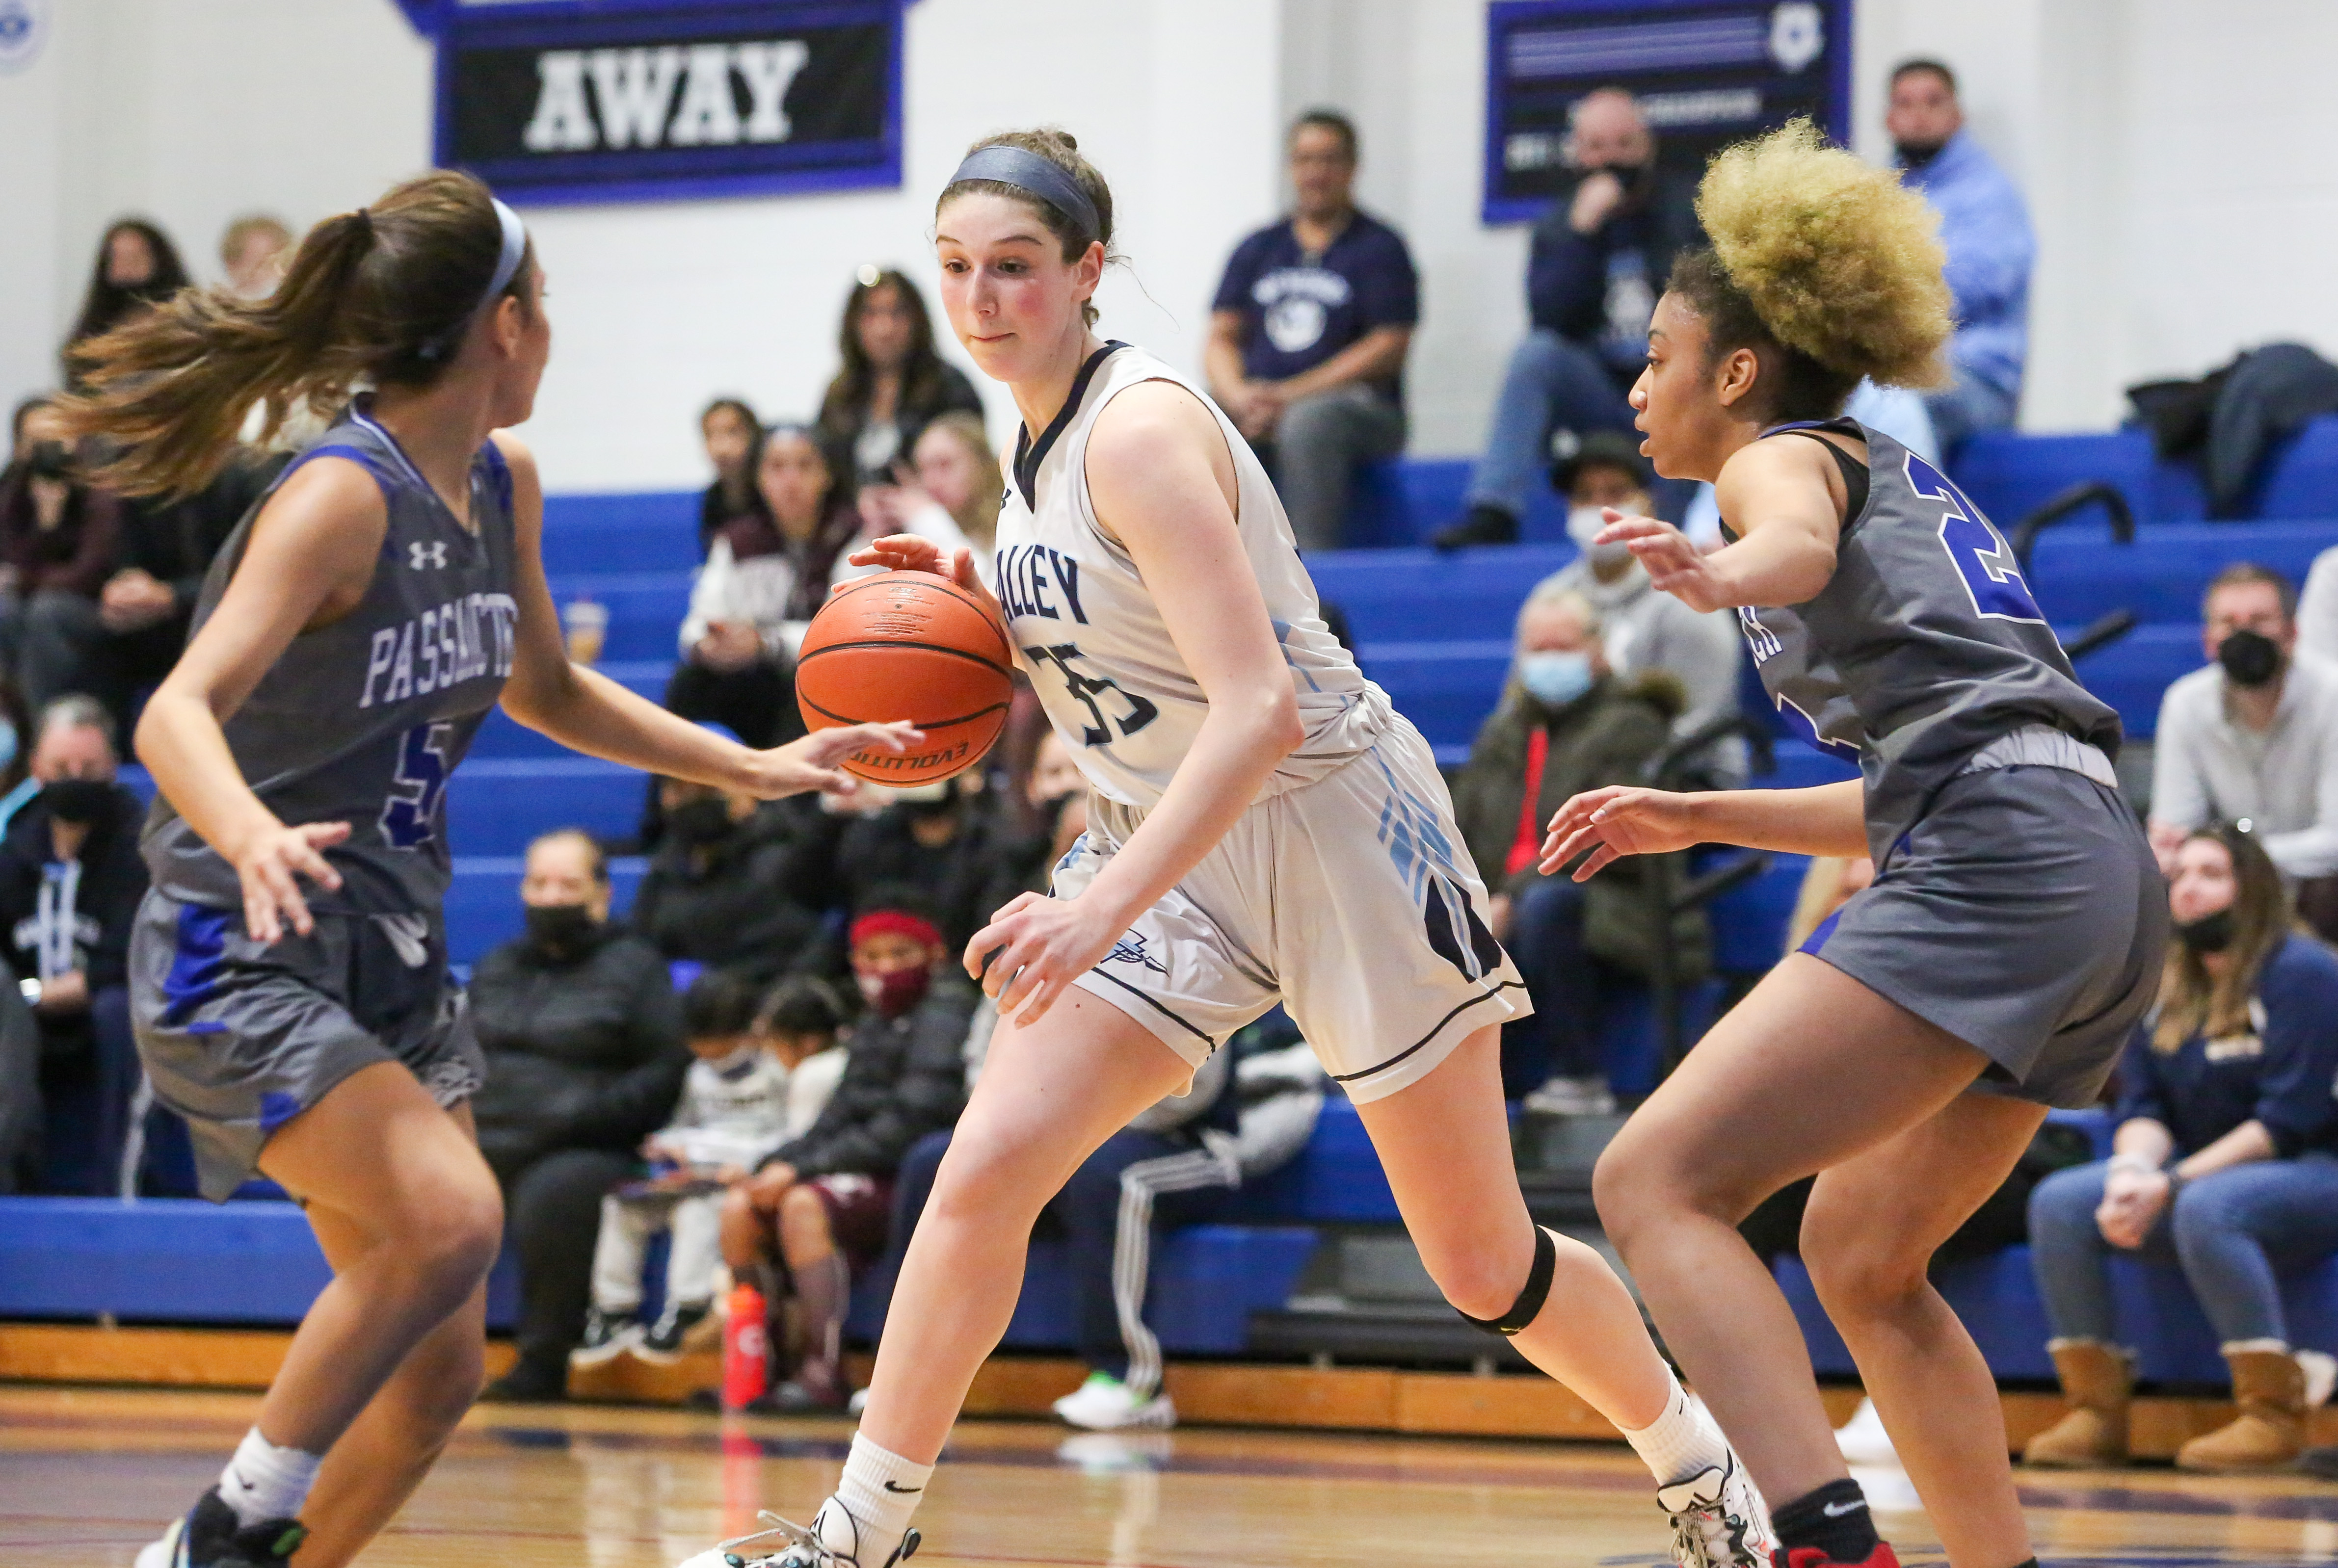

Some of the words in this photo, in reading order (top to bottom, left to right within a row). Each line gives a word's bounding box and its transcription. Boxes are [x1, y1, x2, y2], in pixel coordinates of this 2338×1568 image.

[522, 40, 809, 151] AWAY
[995, 544, 1089, 626] ALLEY
[377, 722, 452, 852] 5
